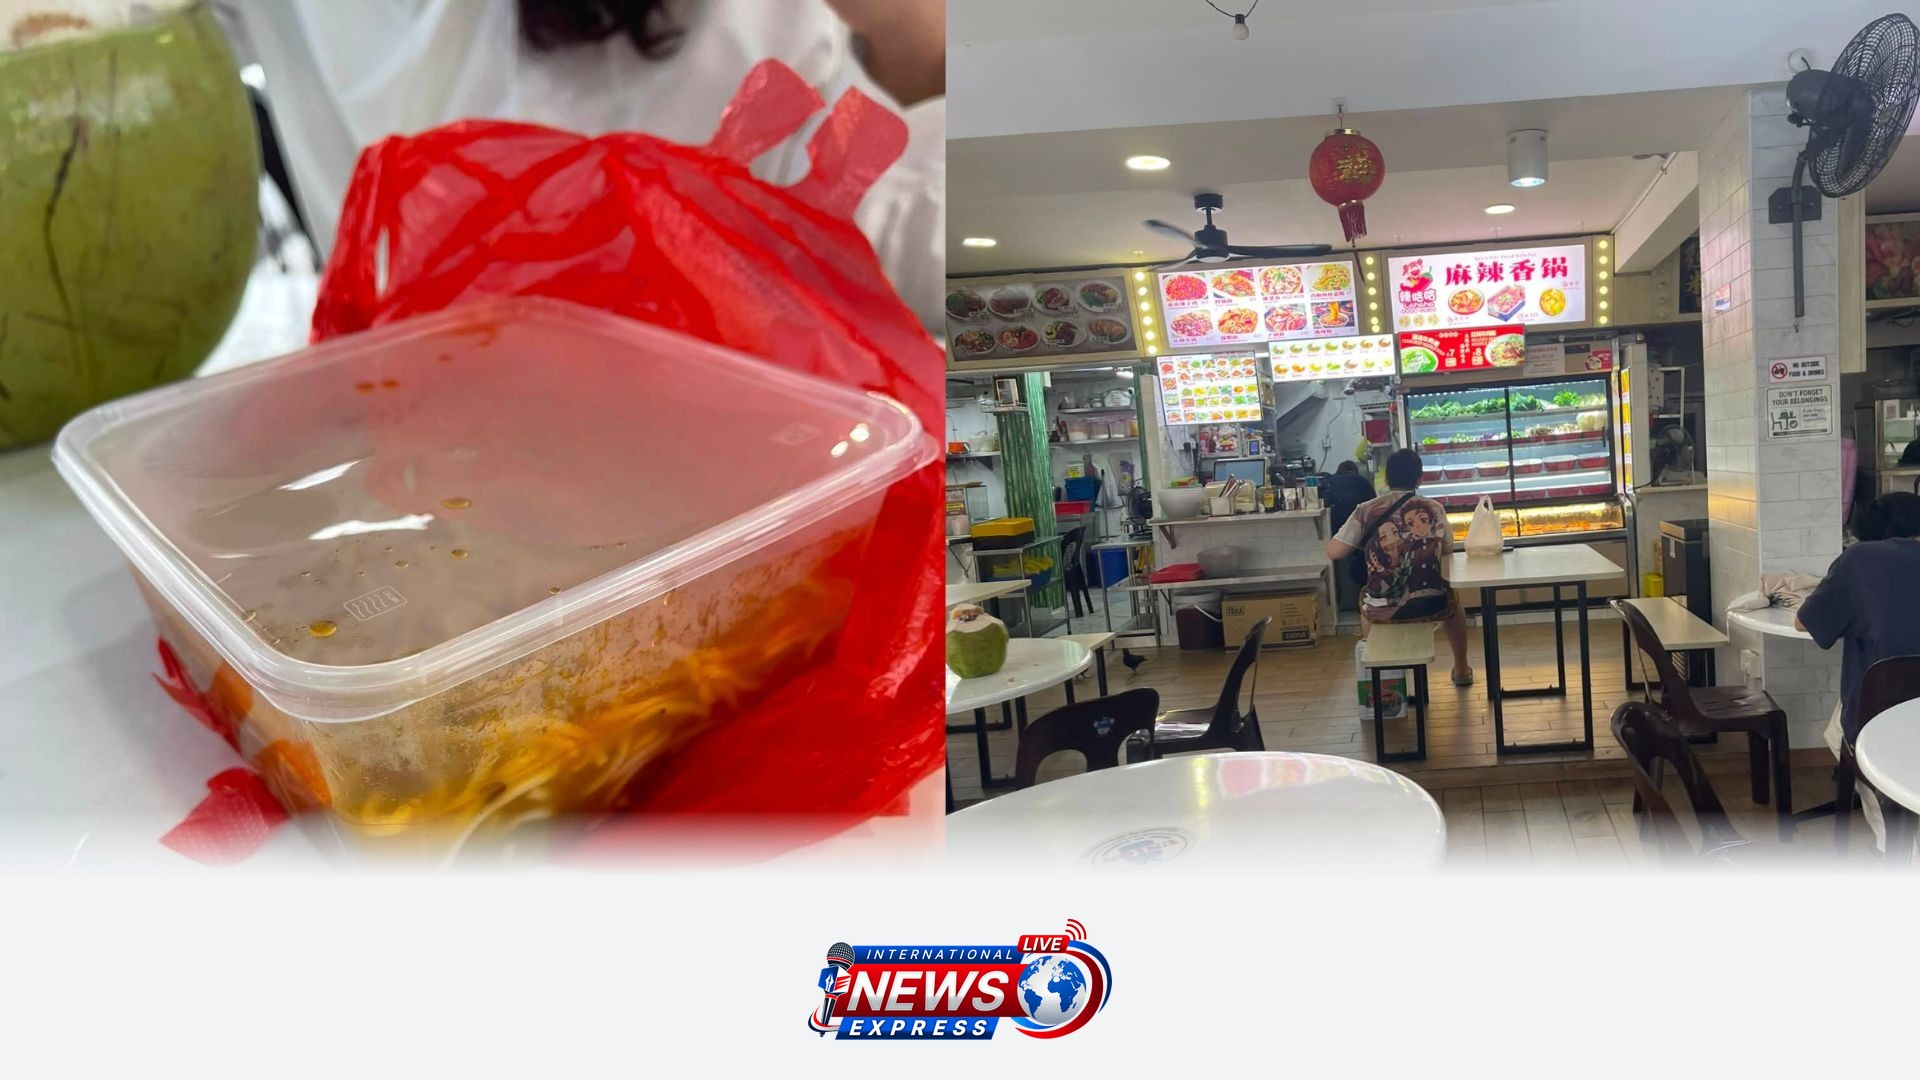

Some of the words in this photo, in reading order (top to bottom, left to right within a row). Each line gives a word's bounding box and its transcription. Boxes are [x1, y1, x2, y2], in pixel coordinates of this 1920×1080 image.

[1445, 257, 1568, 286] 麻辣香锅
[1790, 396, 1828, 405] BELONGINGS
